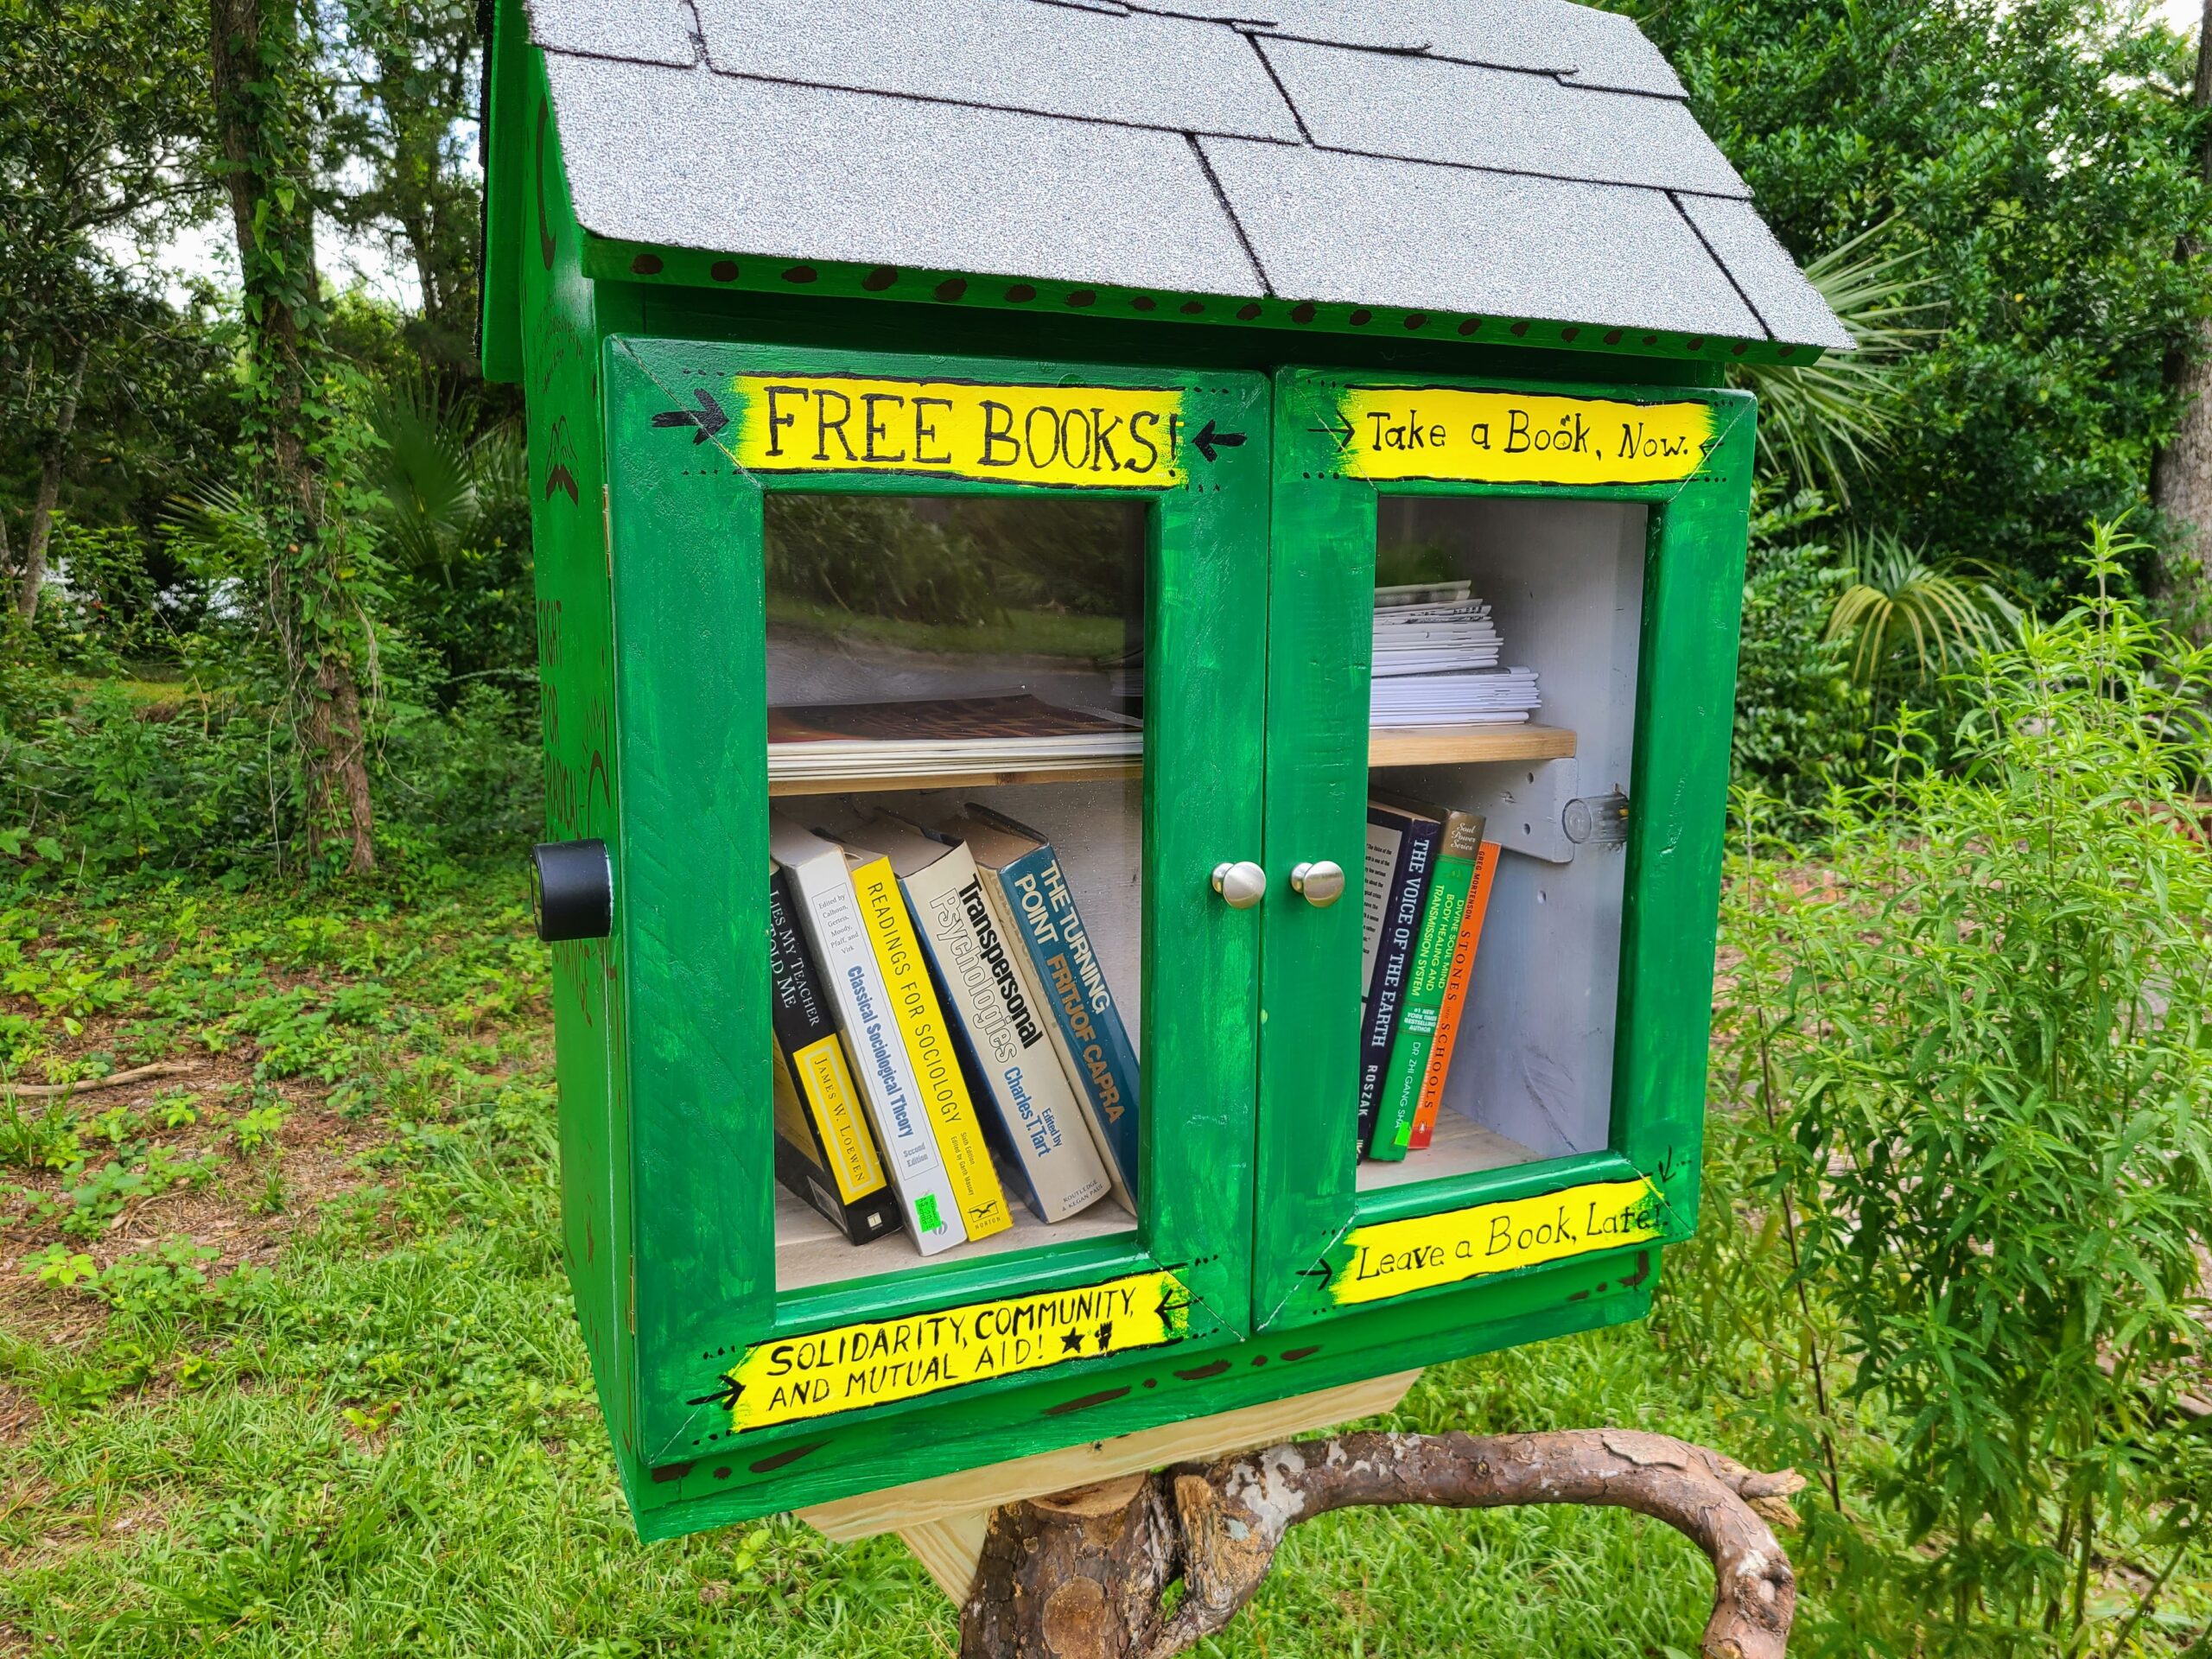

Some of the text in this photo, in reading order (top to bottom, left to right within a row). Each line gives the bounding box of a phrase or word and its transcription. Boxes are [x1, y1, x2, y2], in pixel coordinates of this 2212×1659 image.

[763, 385, 1179, 479] FREE BOOKS!
[1367, 409, 1690, 461] Take a Book, Now.
[1451, 840, 1473, 851] Series
[1452, 830, 1476, 842] Power
[1457, 823, 1476, 834] Soul
[818, 897, 837, 910] Edited
[822, 904, 849, 919] Calhoun,
[1014, 874, 1059, 944] POINT
[1465, 850, 1484, 920] GREG MORTENSON
[830, 925, 854, 938] Moody,
[848, 931, 859, 941] and
[958, 873, 1044, 1050] Transpersonal
[1040, 860, 1110, 1014] THE TURNING
[1371, 839, 1429, 1047] THE VOICE OF THE EARTH
[1411, 885, 1445, 996] TRANSMISSION SYSTEM
[1426, 893, 1455, 991] BODY HEALING AND
[1438, 899, 1465, 988] DIVINE SOUL MIND
[777, 976, 797, 1008] ME
[779, 929, 796, 956] MY
[791, 957, 820, 1027] TEACHER
[929, 887, 1018, 1064] Psychologies
[1448, 930, 1471, 1001] STONES
[868, 881, 963, 1124] READINGS FOR SOCIOLOGY
[848, 965, 914, 1138] Classical Sociological Theory
[1047, 952, 1126, 1124] FRITJOF CAPRA
[1408, 1059, 1417, 1074] ZHI
[1412, 1041, 1421, 1056] DR
[1424, 1023, 1451, 1108] SCHOOLS
[814, 1057, 865, 1181] JAMES W. LOEWEN
[1004, 1065, 1051, 1158] Charles T. Tart
[1358, 1065, 1378, 1116] ROSZAK
[1400, 1076, 1413, 1107] GANG
[903, 1142, 925, 1158] Second
[950, 1135, 961, 1154] Edited
[964, 1145, 975, 1166] Edition
[1041, 1107, 1062, 1147] Edited by
[906, 1154, 929, 1167] Edition
[1063, 1179, 1097, 1203] ROUTLEDGE
[975, 1217, 1001, 1230] NORTON
[1356, 1243, 1446, 1281] Leave
[1455, 1241, 1473, 1259] a
[1484, 1205, 1578, 1257] Book,
[767, 1334, 1045, 1412] AND MUTUAL AID!
